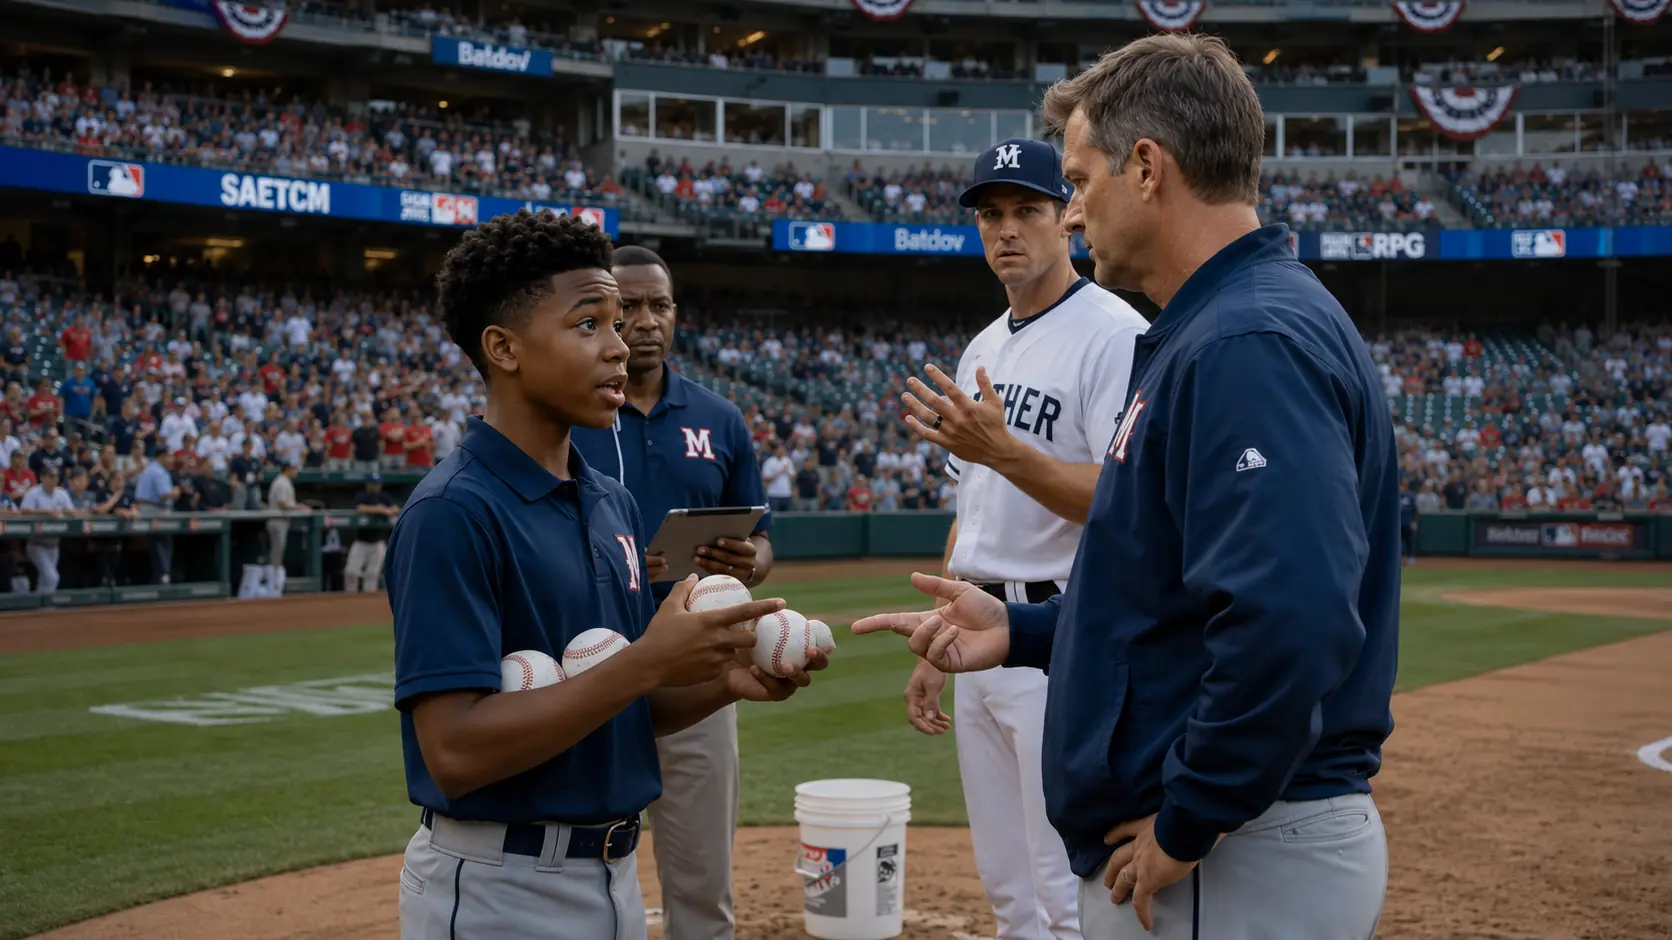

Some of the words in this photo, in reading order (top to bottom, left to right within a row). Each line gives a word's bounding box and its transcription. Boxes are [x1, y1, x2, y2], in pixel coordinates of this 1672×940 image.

[993, 143, 1022, 170] M
[220, 173, 330, 214] SAETCM
[1373, 232, 1425, 259] RPG
[680, 426, 716, 461] M
